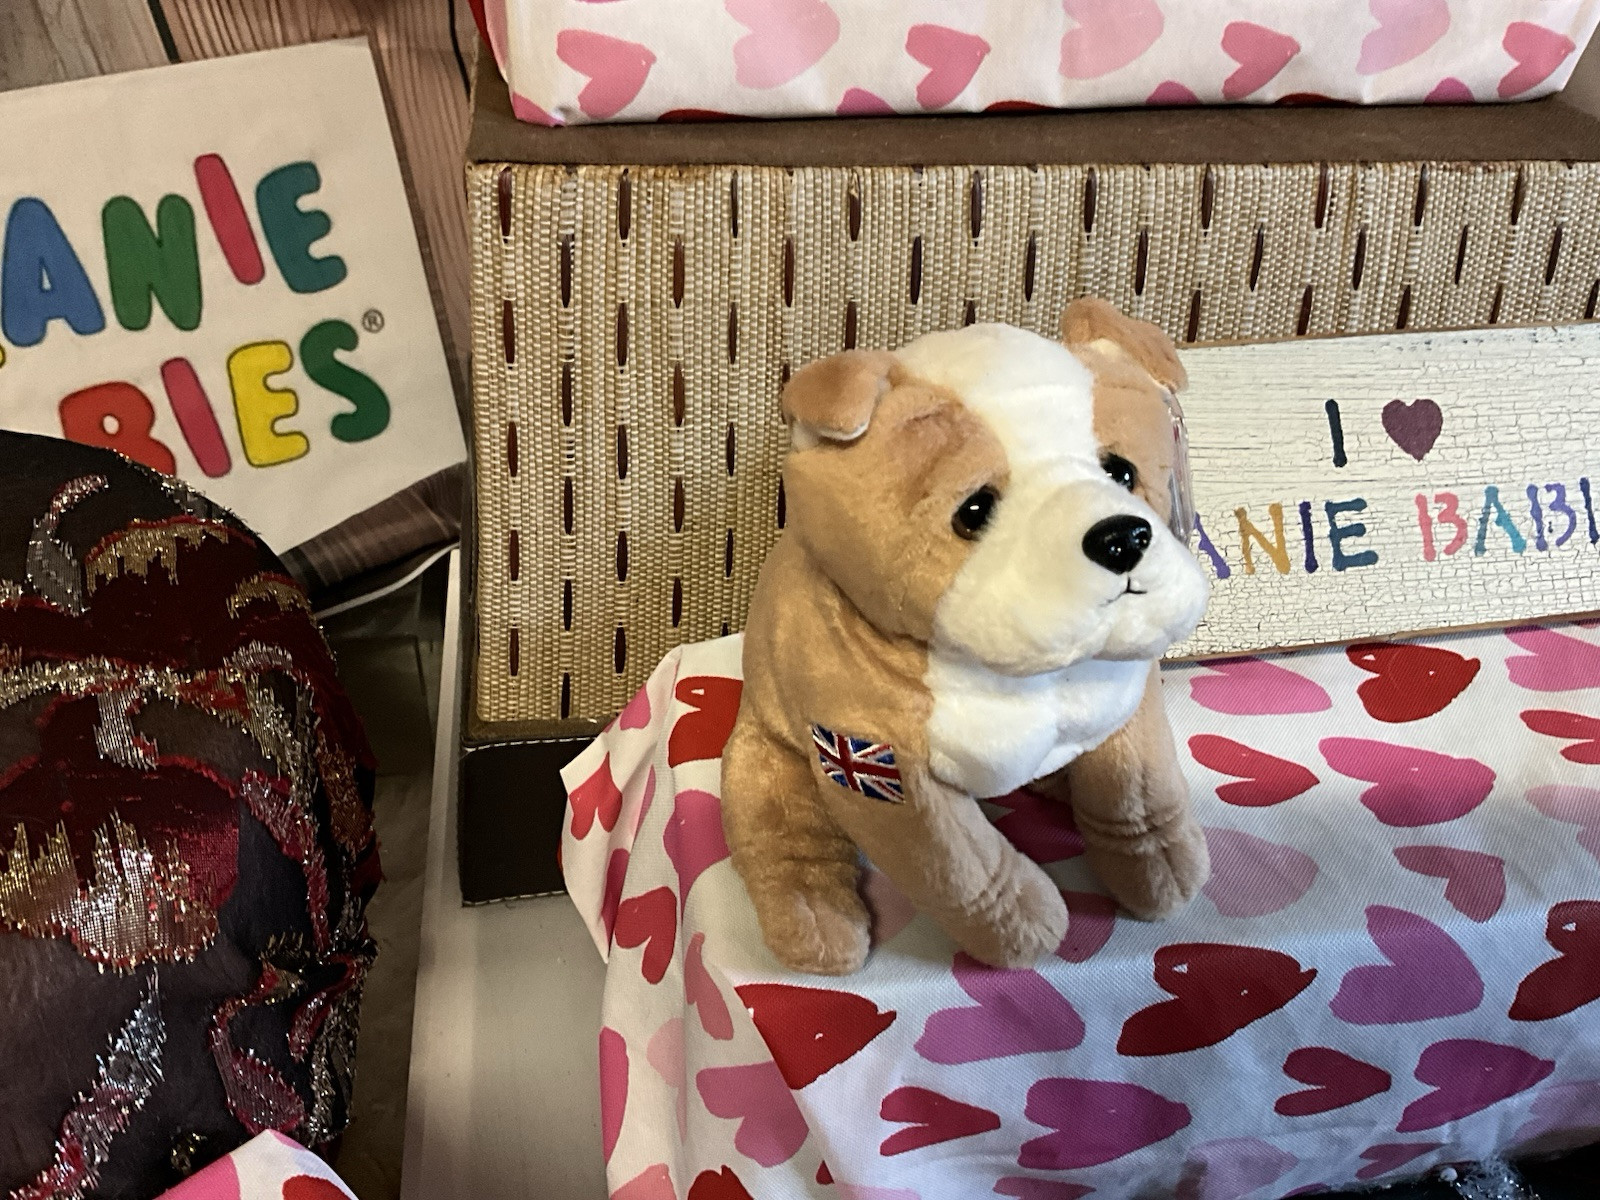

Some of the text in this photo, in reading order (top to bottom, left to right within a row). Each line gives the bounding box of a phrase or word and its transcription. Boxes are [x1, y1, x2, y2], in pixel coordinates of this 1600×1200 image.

[0, 153, 347, 369] ANIE
[1325, 399, 1348, 467] I
[1415, 477, 1600, 562] BABI
